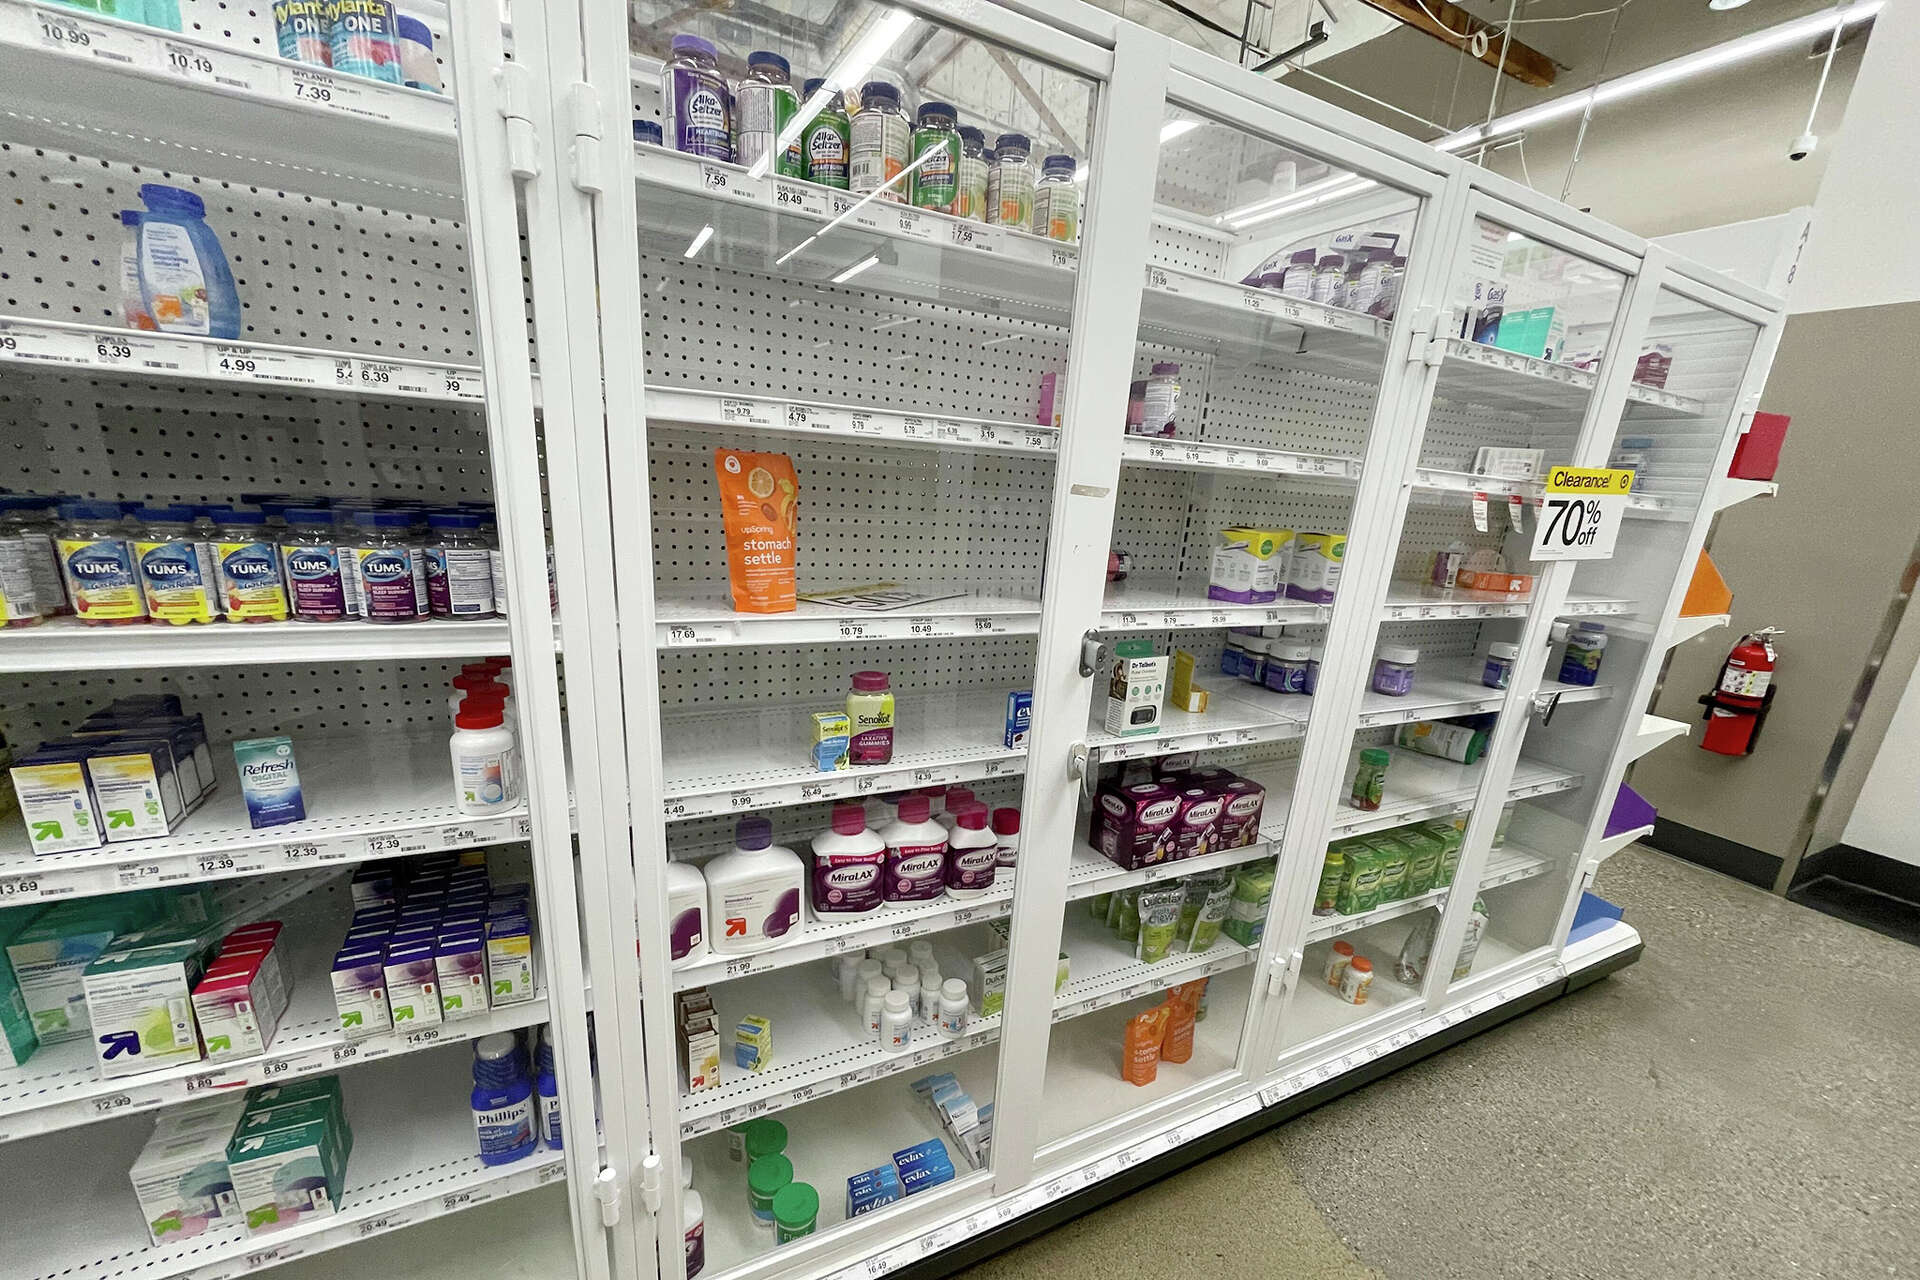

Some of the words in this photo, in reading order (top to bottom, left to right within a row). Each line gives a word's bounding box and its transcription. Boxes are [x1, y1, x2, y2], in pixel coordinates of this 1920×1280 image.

[344, 17, 382, 33] ONE
[41, 23, 90, 46] 10.99
[169, 52, 213, 73] 10.19
[294, 82, 331, 102] 7.39
[692, 104, 721, 116] Seltzer
[812, 141, 841, 151] Seltzer
[705, 173, 726, 187] 7.59
[777, 192, 802, 205] 20.49
[957, 231, 972, 242] 7.59
[97, 344, 131, 358] 6.39
[220, 358, 256, 372] 4.99
[361, 370, 389, 383] 6.39
[789, 413, 806, 422] 4.79
[980, 430, 995, 439] 3.19
[1554, 471, 1613, 488] Clearance!
[1578, 526, 1598, 546] off
[744, 537, 792, 551] stomach
[744, 552, 782, 565] settle
[75, 563, 120, 574] TUMS
[146, 563, 188, 574] TUMS
[231, 563, 269, 574] TUMS
[292, 561, 328, 570] TUMS
[367, 563, 402, 573] TUMS
[671, 631, 696, 639] 17.69
[911, 625, 932, 634] 10.49
[858, 711, 890, 724] Senokot
[243, 759, 293, 776] Refresh
[732, 797, 751, 807] 9.99
[664, 806, 685, 814] 4.49
[1144, 806, 1175, 819] MiraLAX
[1189, 807, 1217, 818] MiraLAX
[369, 839, 400, 851] 12.39
[285, 847, 318, 858] 12.39
[961, 851, 995, 865] MiraLAX
[200, 859, 233, 871] 12.39
[901, 858, 939, 872] MiraLAX
[831, 869, 874, 882] MiraLAX
[727, 962, 750, 974] 21.99
[407, 1031, 438, 1044] 14.99
[334, 1048, 356, 1059] 8.89
[264, 1063, 288, 1075] 8.89
[187, 1079, 212, 1091] 8.89
